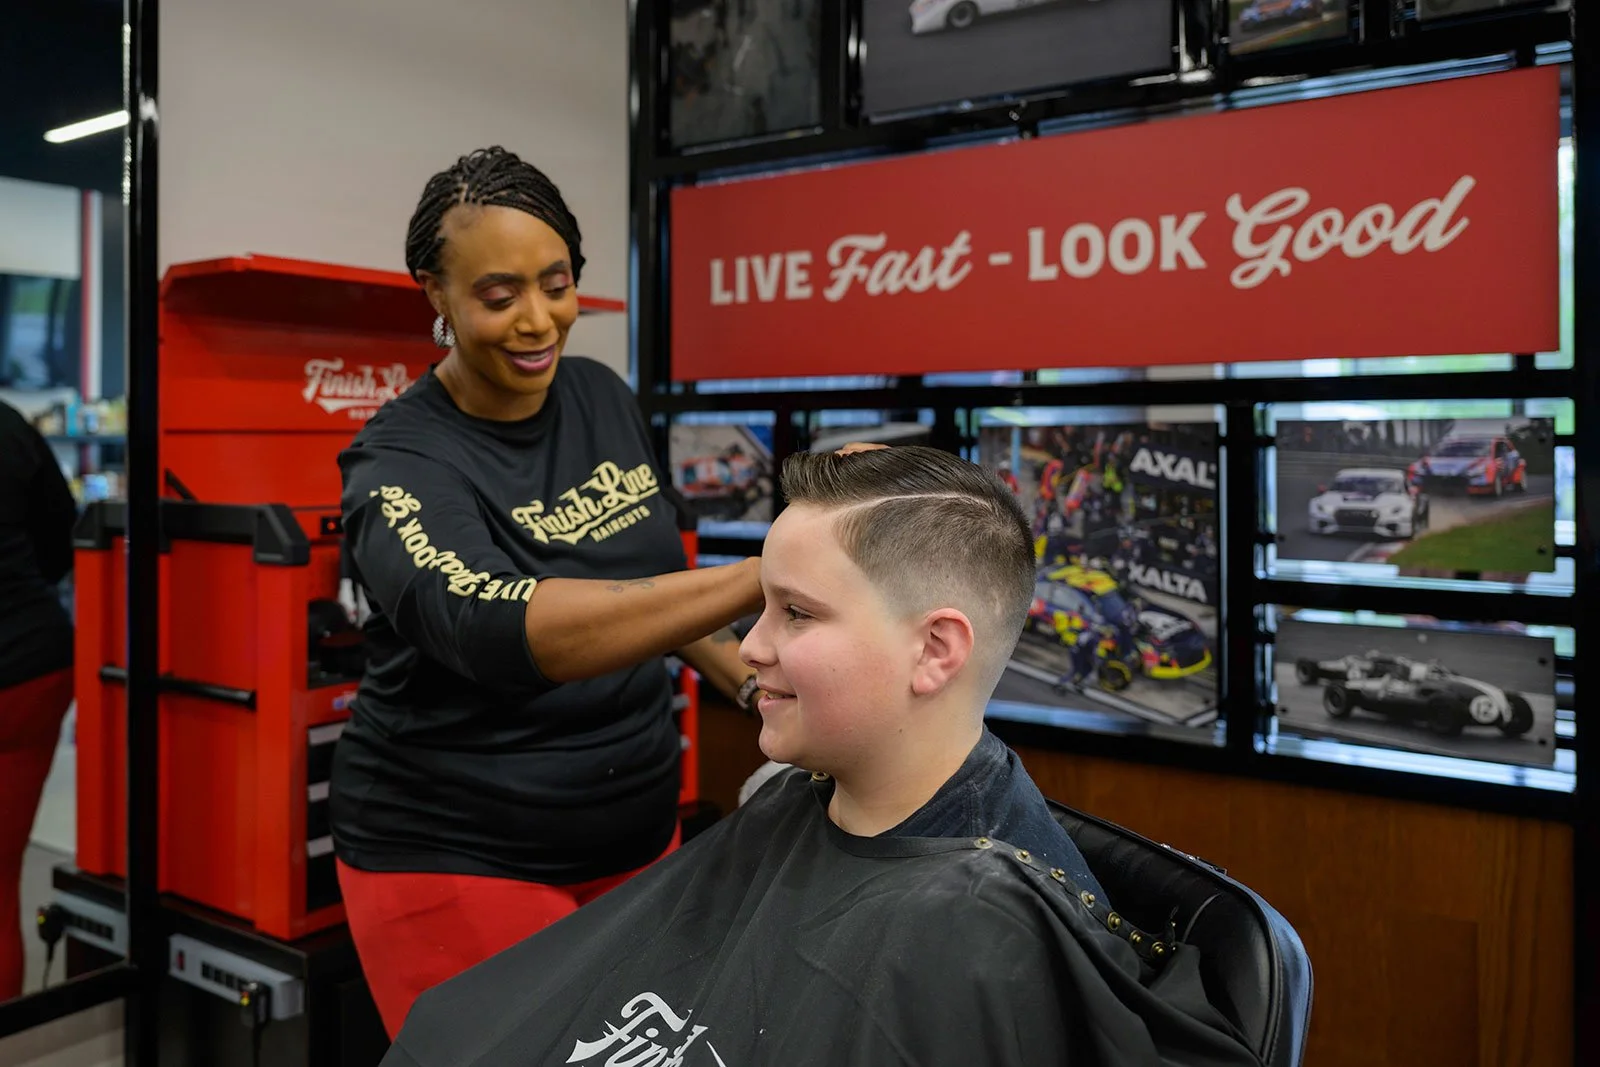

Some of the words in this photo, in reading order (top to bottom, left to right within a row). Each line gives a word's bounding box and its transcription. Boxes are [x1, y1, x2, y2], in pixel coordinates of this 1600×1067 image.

[709, 250, 813, 305] LIVE
[822, 230, 973, 303] Fast
[1027, 211, 1207, 282] LOOK
[1225, 174, 1477, 290] Good
[302, 357, 378, 404] Finish
[1130, 447, 1217, 490] AXAL
[511, 486, 603, 545] Finish
[577, 460, 658, 509] Line
[589, 504, 652, 543] HAIRCUTS
[397, 517, 439, 569] OOK
[428, 551, 492, 597] Fast
[477, 577, 539, 602] LIVE
[1127, 560, 1209, 603] XALTA
[1475, 699, 1495, 719] 12
